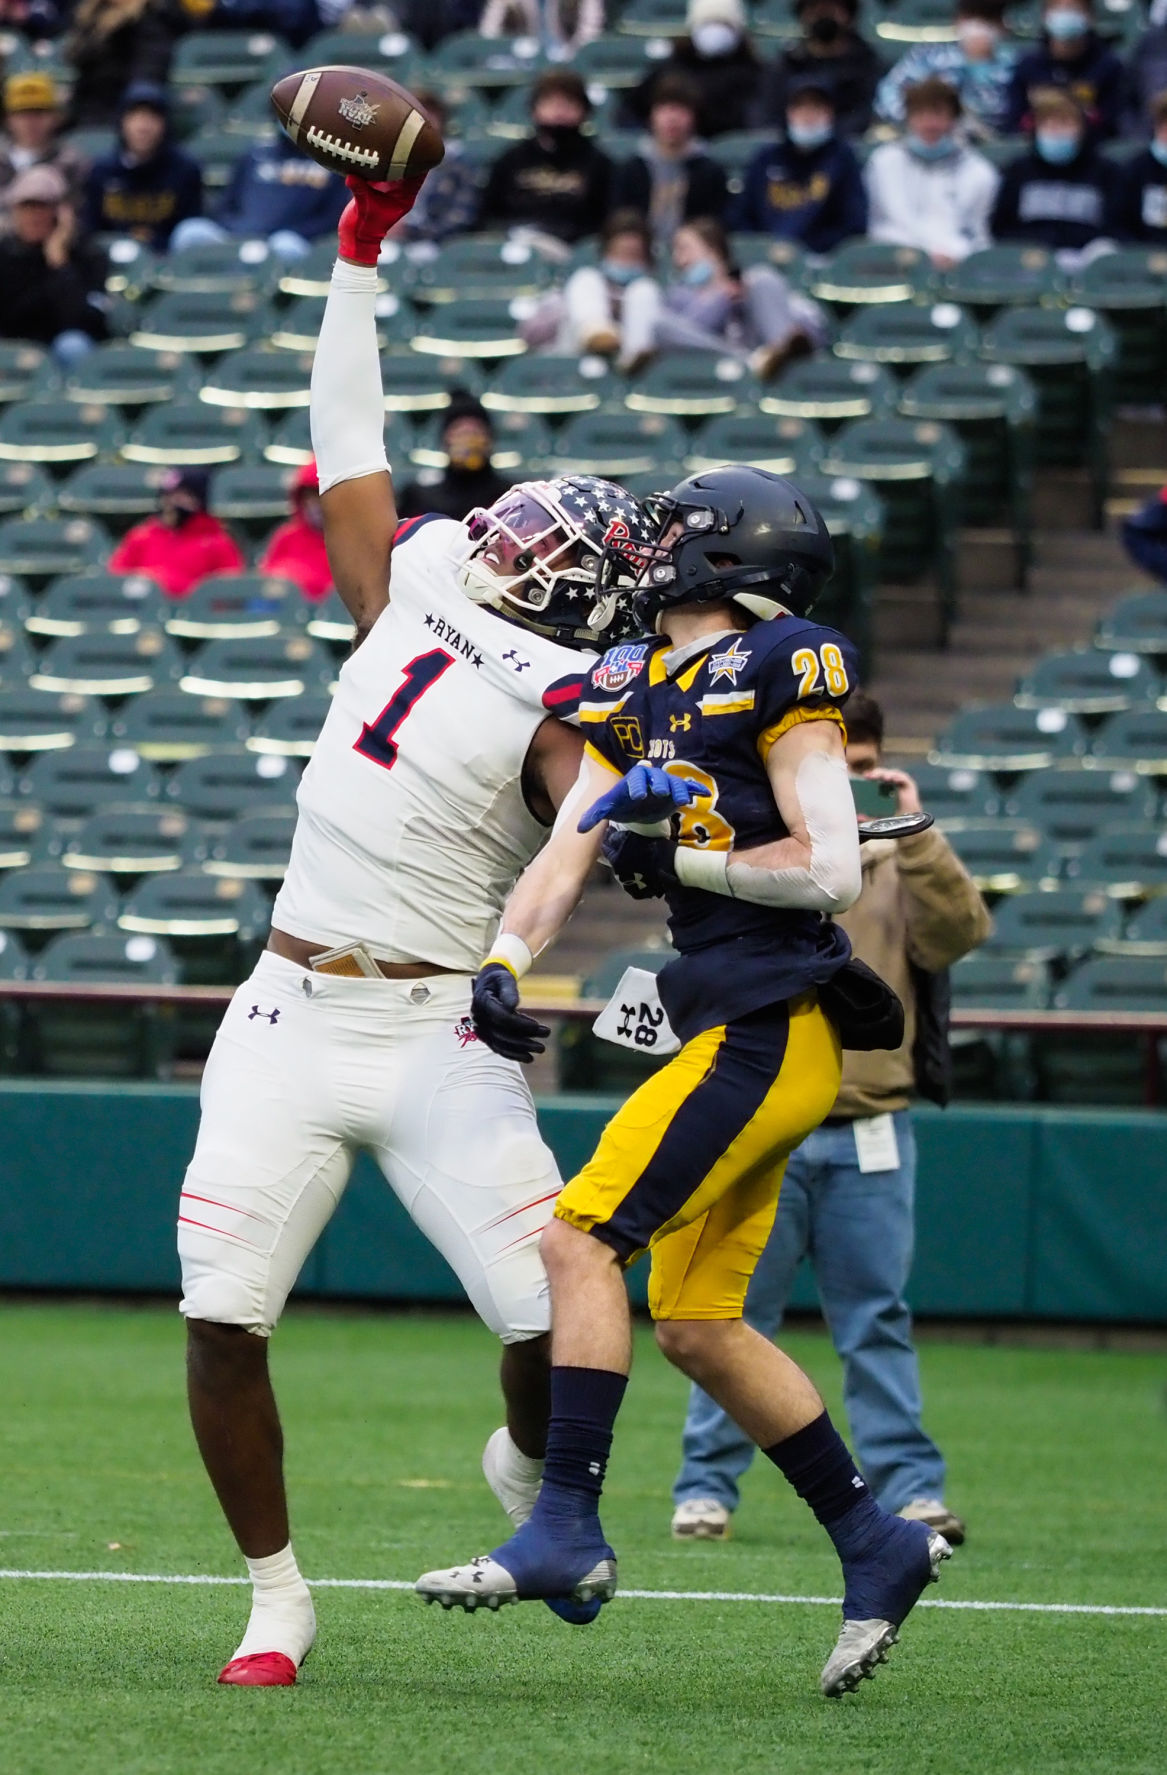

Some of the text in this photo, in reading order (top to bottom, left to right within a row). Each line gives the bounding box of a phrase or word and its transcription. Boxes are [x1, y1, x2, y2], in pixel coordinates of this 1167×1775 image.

[432, 618, 476, 660] RYAN
[601, 644, 649, 668] 100
[791, 643, 849, 700] 28
[352, 647, 457, 771] 1
[640, 760, 736, 853] 8
[634, 1002, 664, 1047] 28
